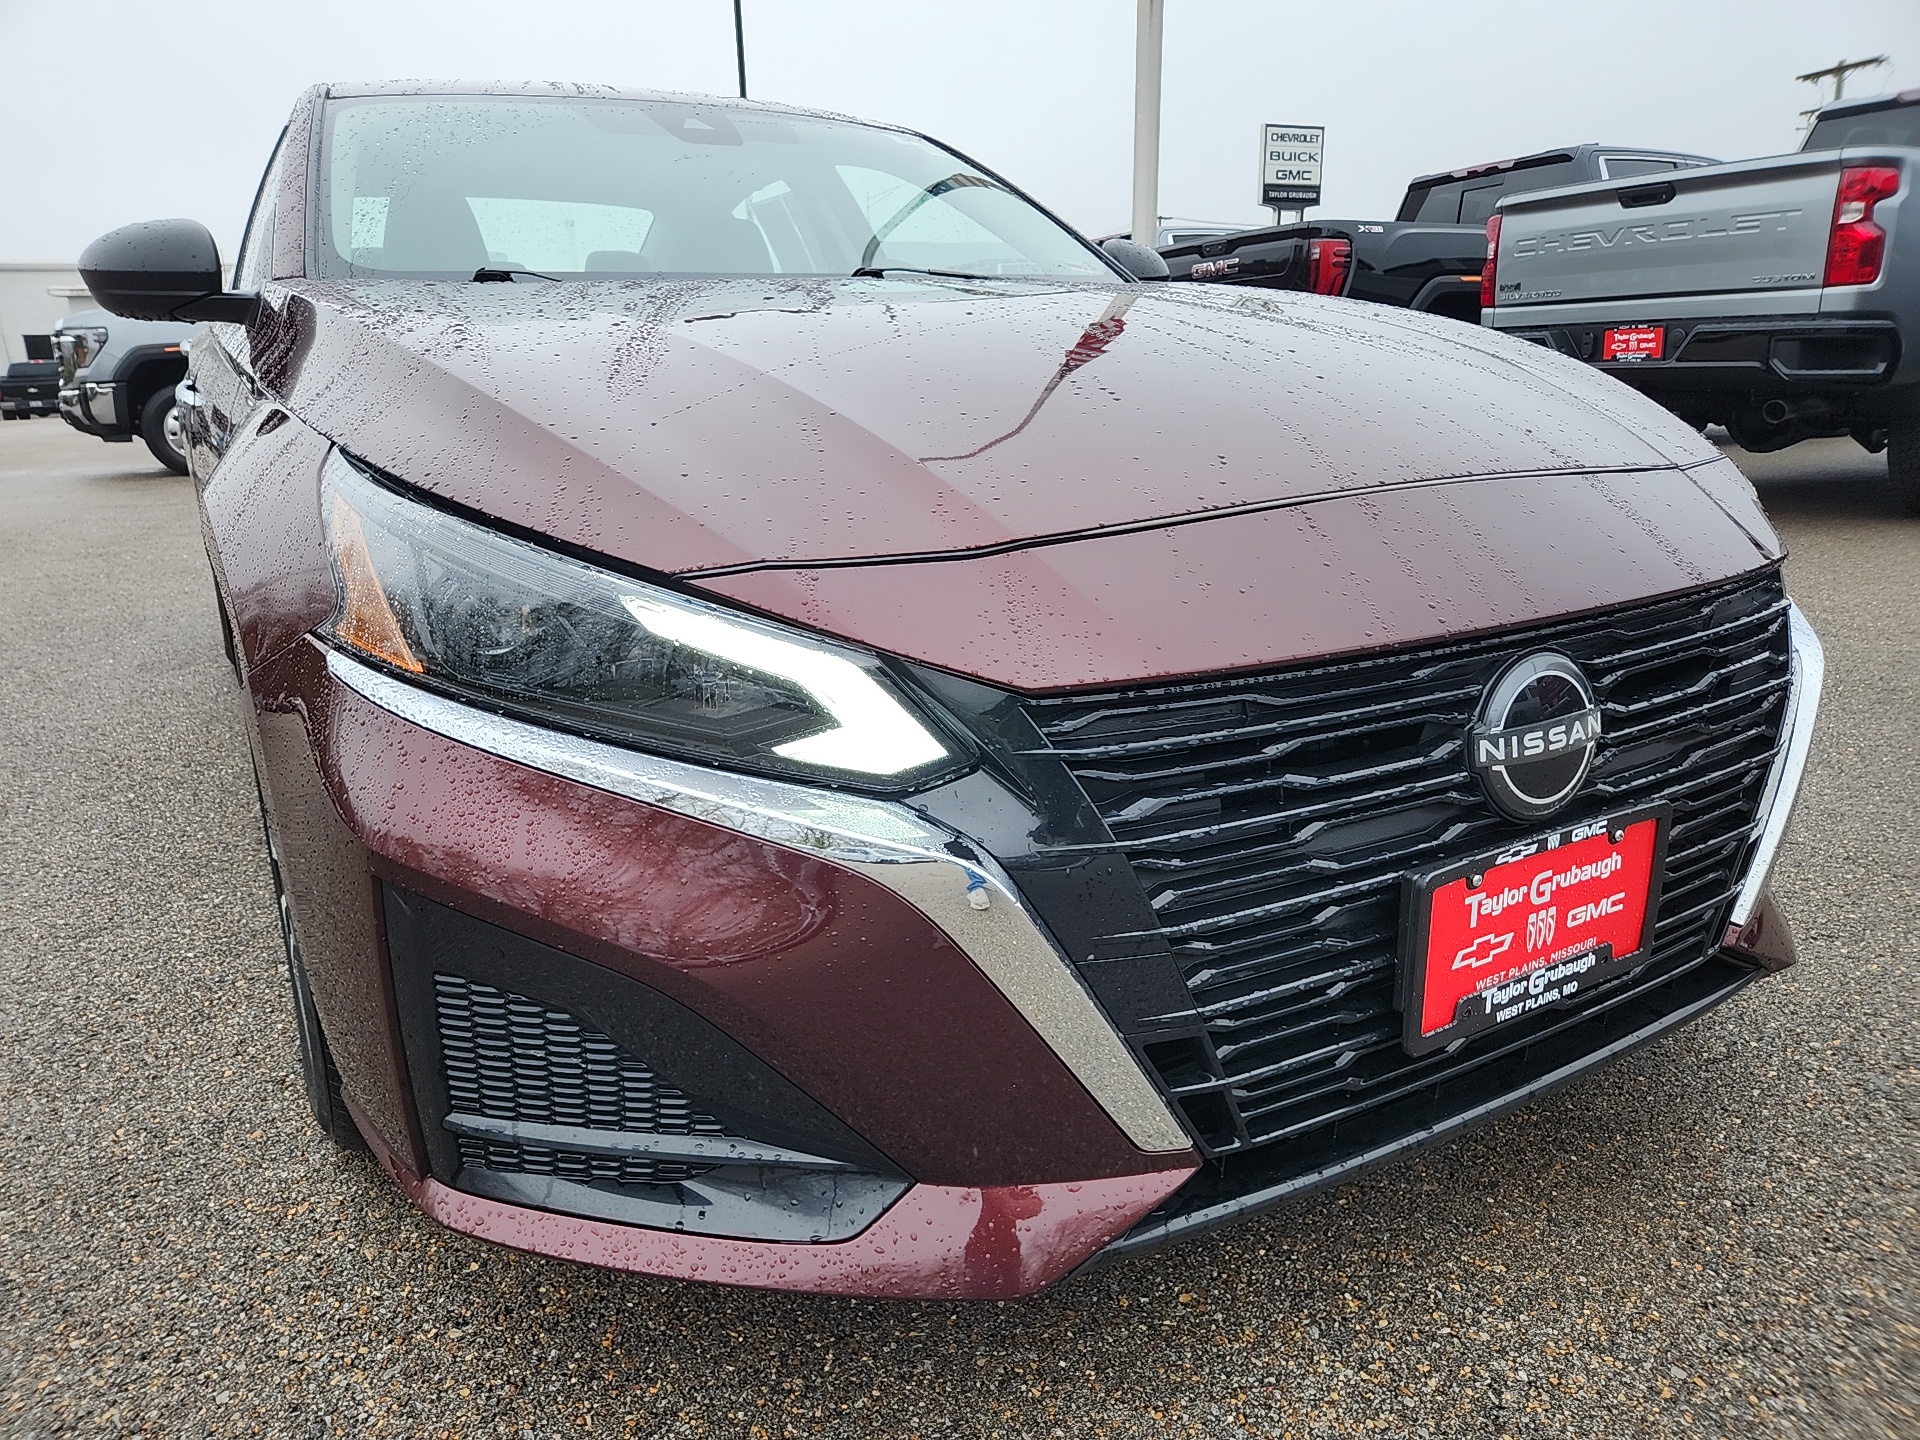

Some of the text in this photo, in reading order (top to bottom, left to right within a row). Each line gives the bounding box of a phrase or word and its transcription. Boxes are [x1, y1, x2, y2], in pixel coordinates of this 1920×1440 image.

[1269, 150, 1319, 162] BUICK
[1270, 132, 1320, 144] CHEVROLET
[1276, 169, 1312, 181] GMC
[1514, 209, 1802, 257] CHEVROLET
[1191, 257, 1240, 279] GMC
[1751, 272, 1816, 284] CUSTOM
[1479, 710, 1600, 763] NISSAN
[1571, 820, 1608, 843] GMC
[1465, 851, 1622, 929] Taylor Grubaugh
[1566, 892, 1625, 928] GMC
[1475, 972, 1506, 991] WEST
[1550, 936, 1597, 962] MISSOURI
[1482, 952, 1596, 1014] Taylor Grubaugh
[1495, 981, 1579, 1023] WEST PLAINS, MO
